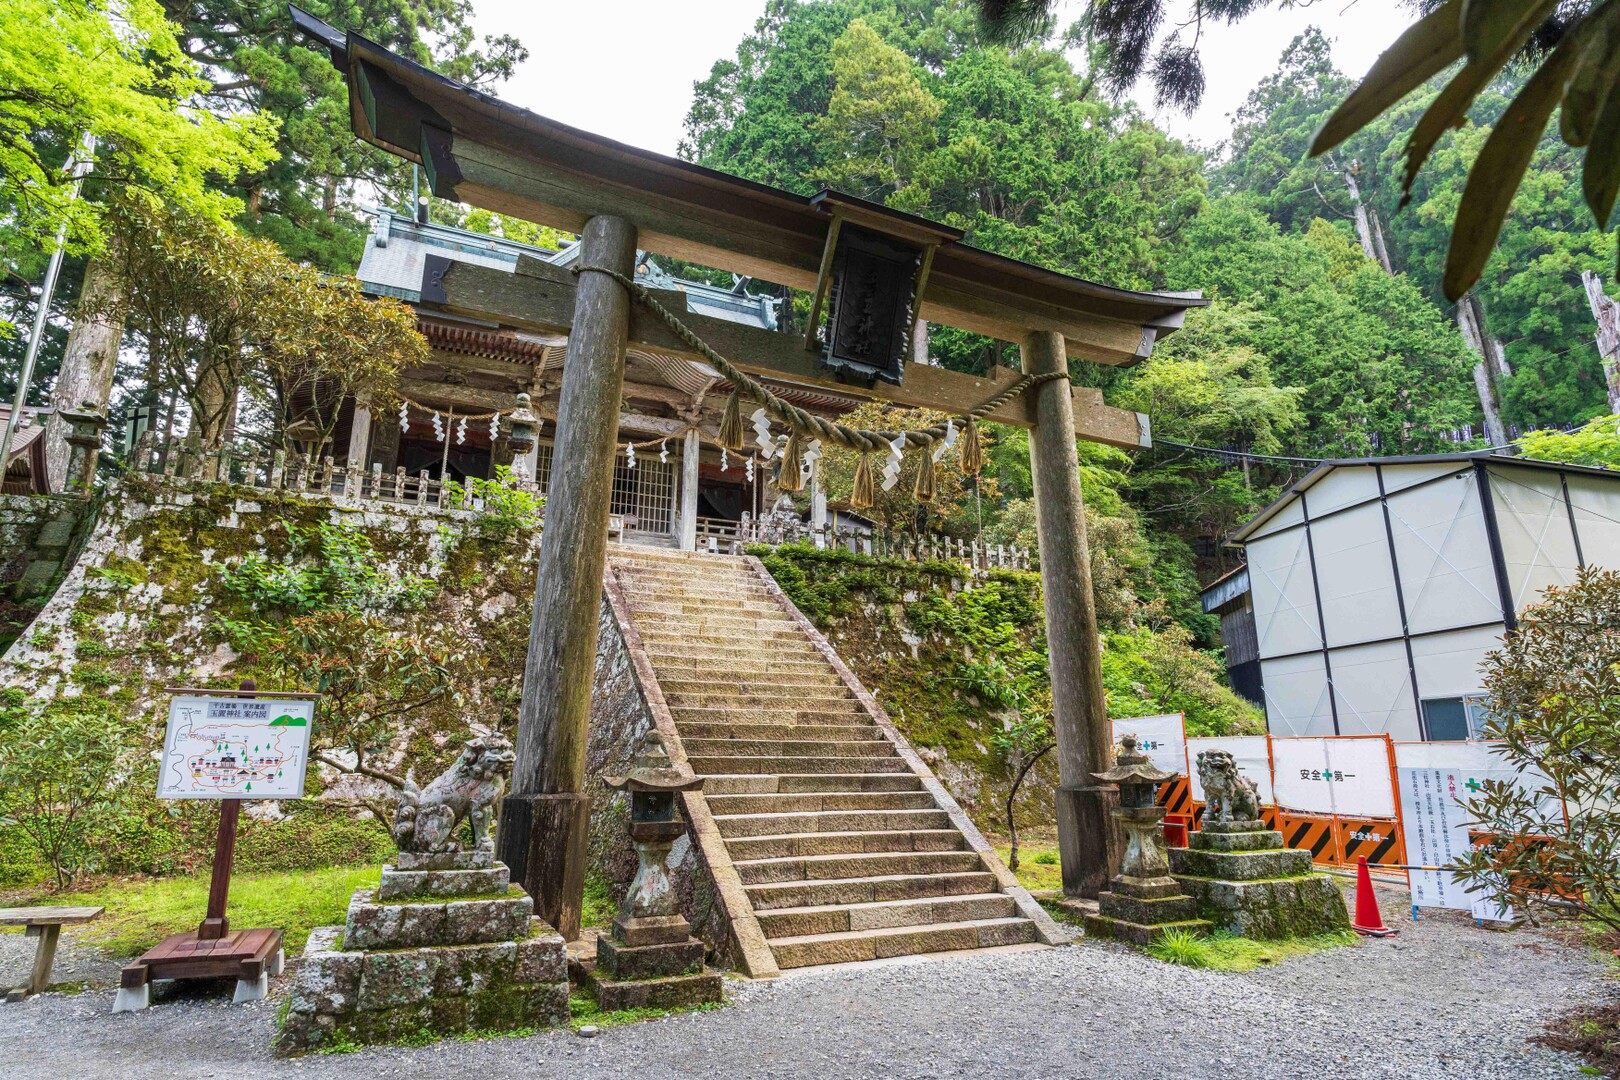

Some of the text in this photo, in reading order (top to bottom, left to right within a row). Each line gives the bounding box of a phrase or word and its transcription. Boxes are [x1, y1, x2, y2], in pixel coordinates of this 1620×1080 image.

[210, 709, 242, 718] 玉置神社
[243, 710, 267, 719] 案内図
[1151, 741, 1164, 750] 第一
[1300, 769, 1355, 782] 安全 第一
[1447, 774, 1457, 797] 進入禁止
